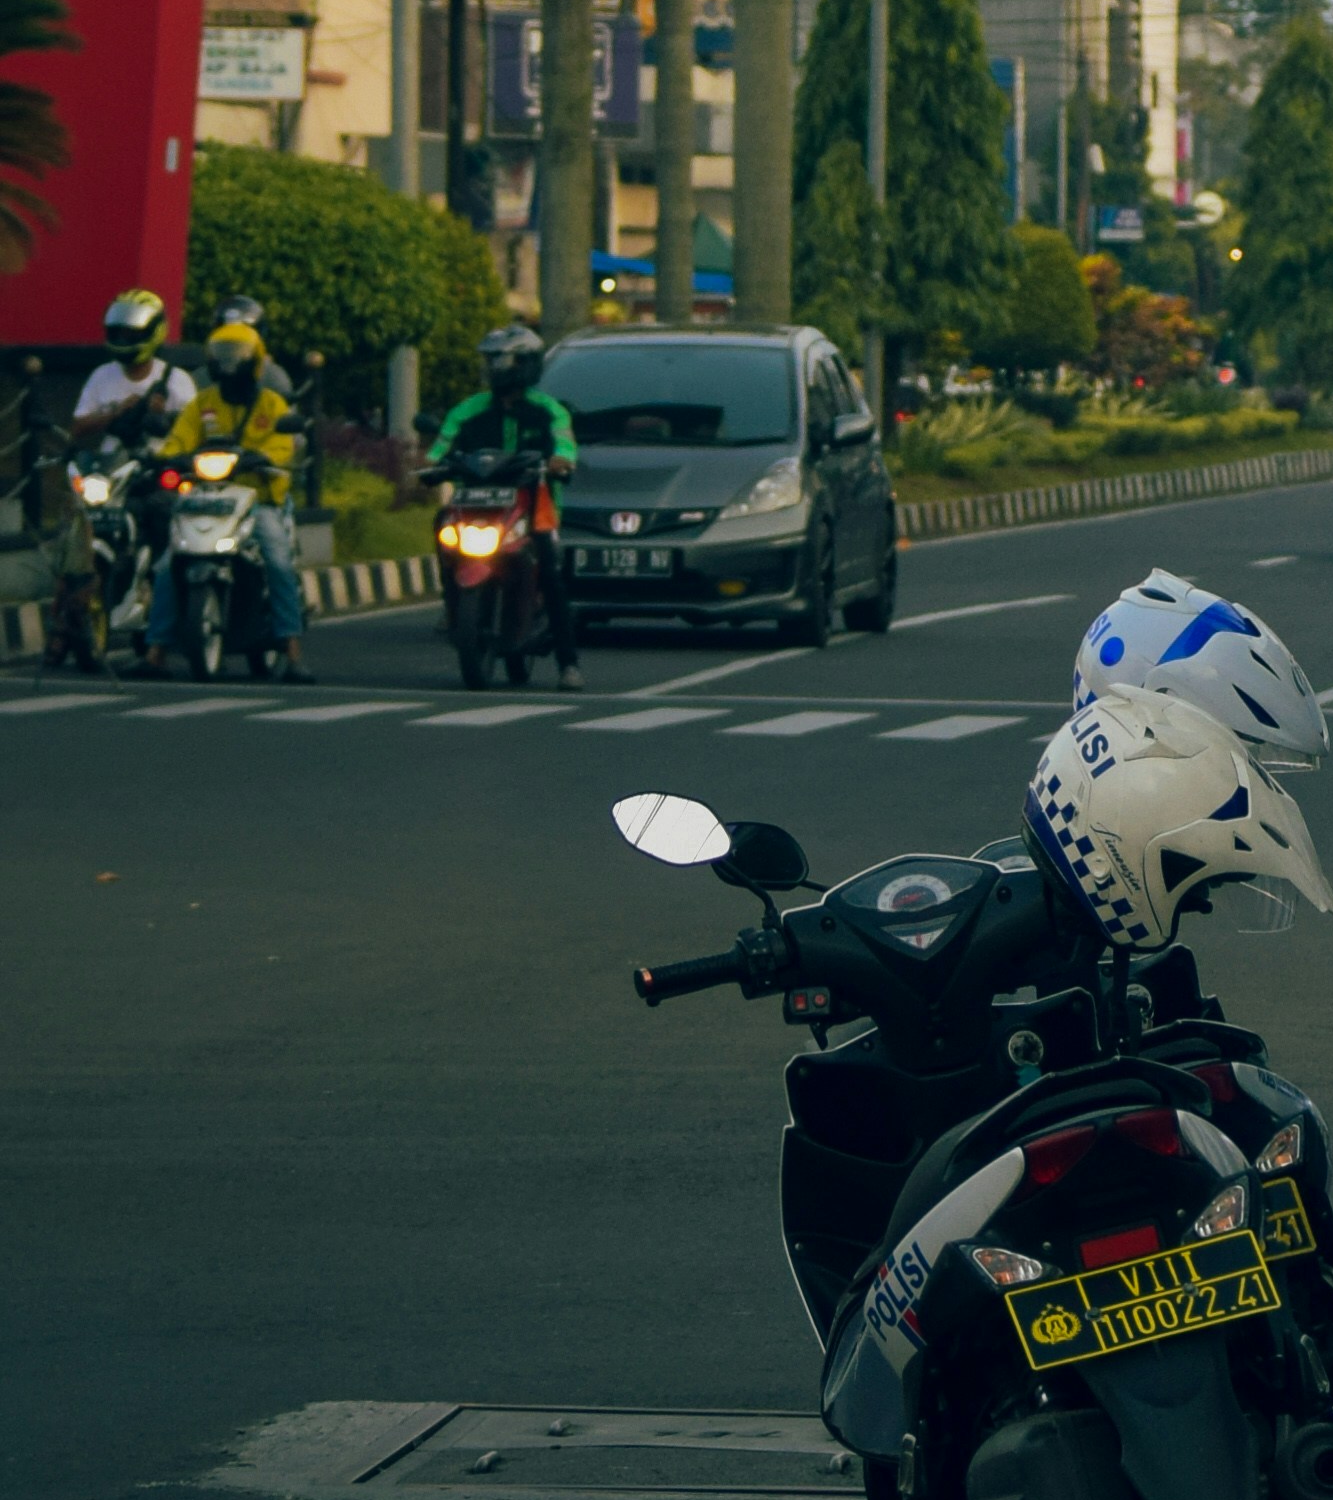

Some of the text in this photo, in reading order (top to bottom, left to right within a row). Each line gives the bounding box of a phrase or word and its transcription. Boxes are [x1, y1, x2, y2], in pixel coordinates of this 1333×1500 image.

[1069, 707, 1116, 780] LISI
[866, 1240, 935, 1343] POLISI
[1099, 1271, 1270, 1344] 110022.41
[1118, 1251, 1201, 1297] VIII
